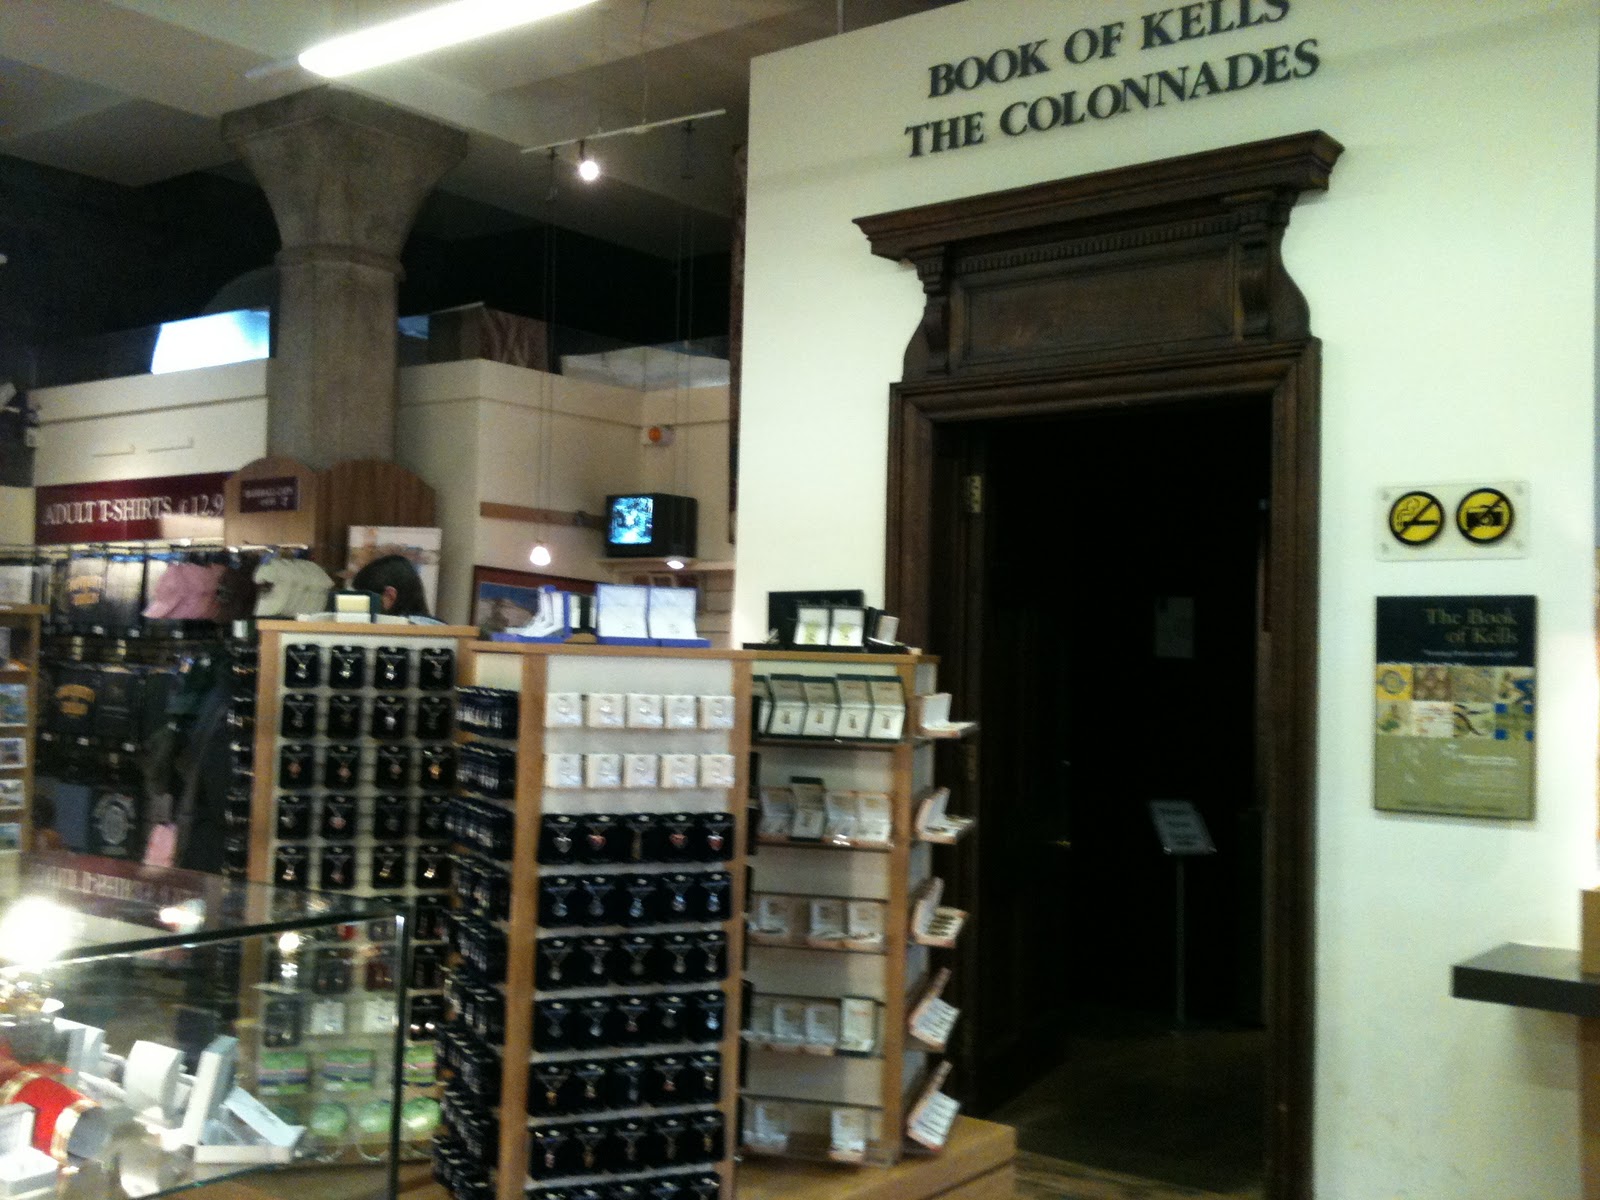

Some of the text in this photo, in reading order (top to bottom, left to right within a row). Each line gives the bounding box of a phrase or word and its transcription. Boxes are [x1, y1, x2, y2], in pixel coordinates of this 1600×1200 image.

[928, 0, 1291, 98] BOOK OF KELLS
[904, 38, 1321, 158] THE COLONNADES
[43, 500, 97, 525] ADULT
[97, 496, 172, 521] T-SHIRTS
[1425, 607, 1518, 625] The Book
